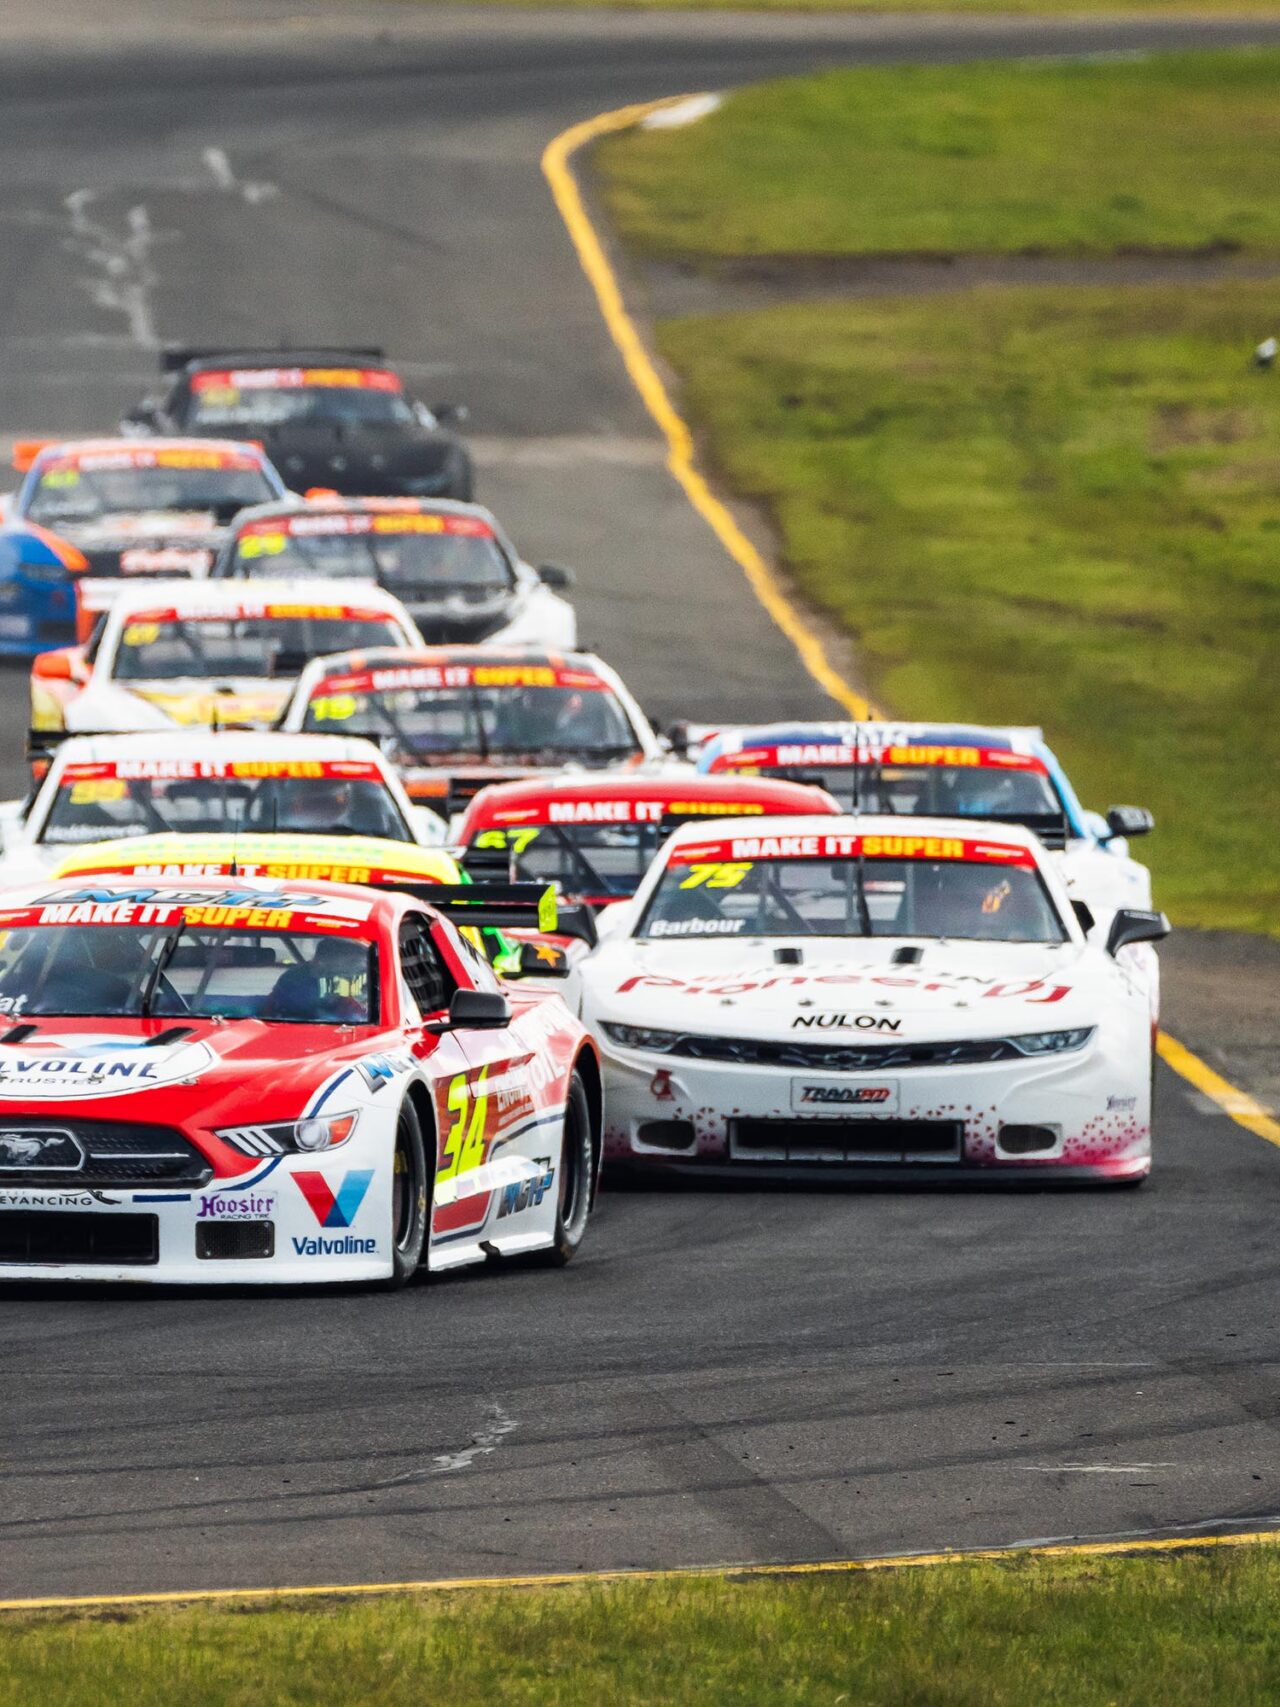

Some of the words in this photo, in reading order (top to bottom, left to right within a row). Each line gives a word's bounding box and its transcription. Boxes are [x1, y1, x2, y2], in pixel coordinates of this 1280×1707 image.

[776, 745, 854, 765] MAKE
[858, 744, 884, 763] IT
[889, 746, 980, 766] SUPER
[116, 761, 204, 779] MAKE
[205, 761, 228, 777] IT
[232, 761, 322, 778] SUPER
[549, 802, 629, 822] MAKE
[634, 802, 665, 820] IT
[475, 828, 540, 853] 67
[731, 839, 819, 858] MAKE
[824, 837, 857, 854] IT
[861, 838, 965, 857] SUPER
[229, 864, 261, 878] T
[679, 861, 754, 889] 75
[39, 903, 134, 924] MAKE
[138, 905, 178, 923] IT
[183, 907, 294, 928] SUPER
[649, 917, 746, 936] Barbour
[791, 1014, 904, 1031] NULON
[436, 1063, 489, 1186] 34
[197, 1193, 274, 1217] Hoosier
[292, 1235, 376, 1256] Valvoline
